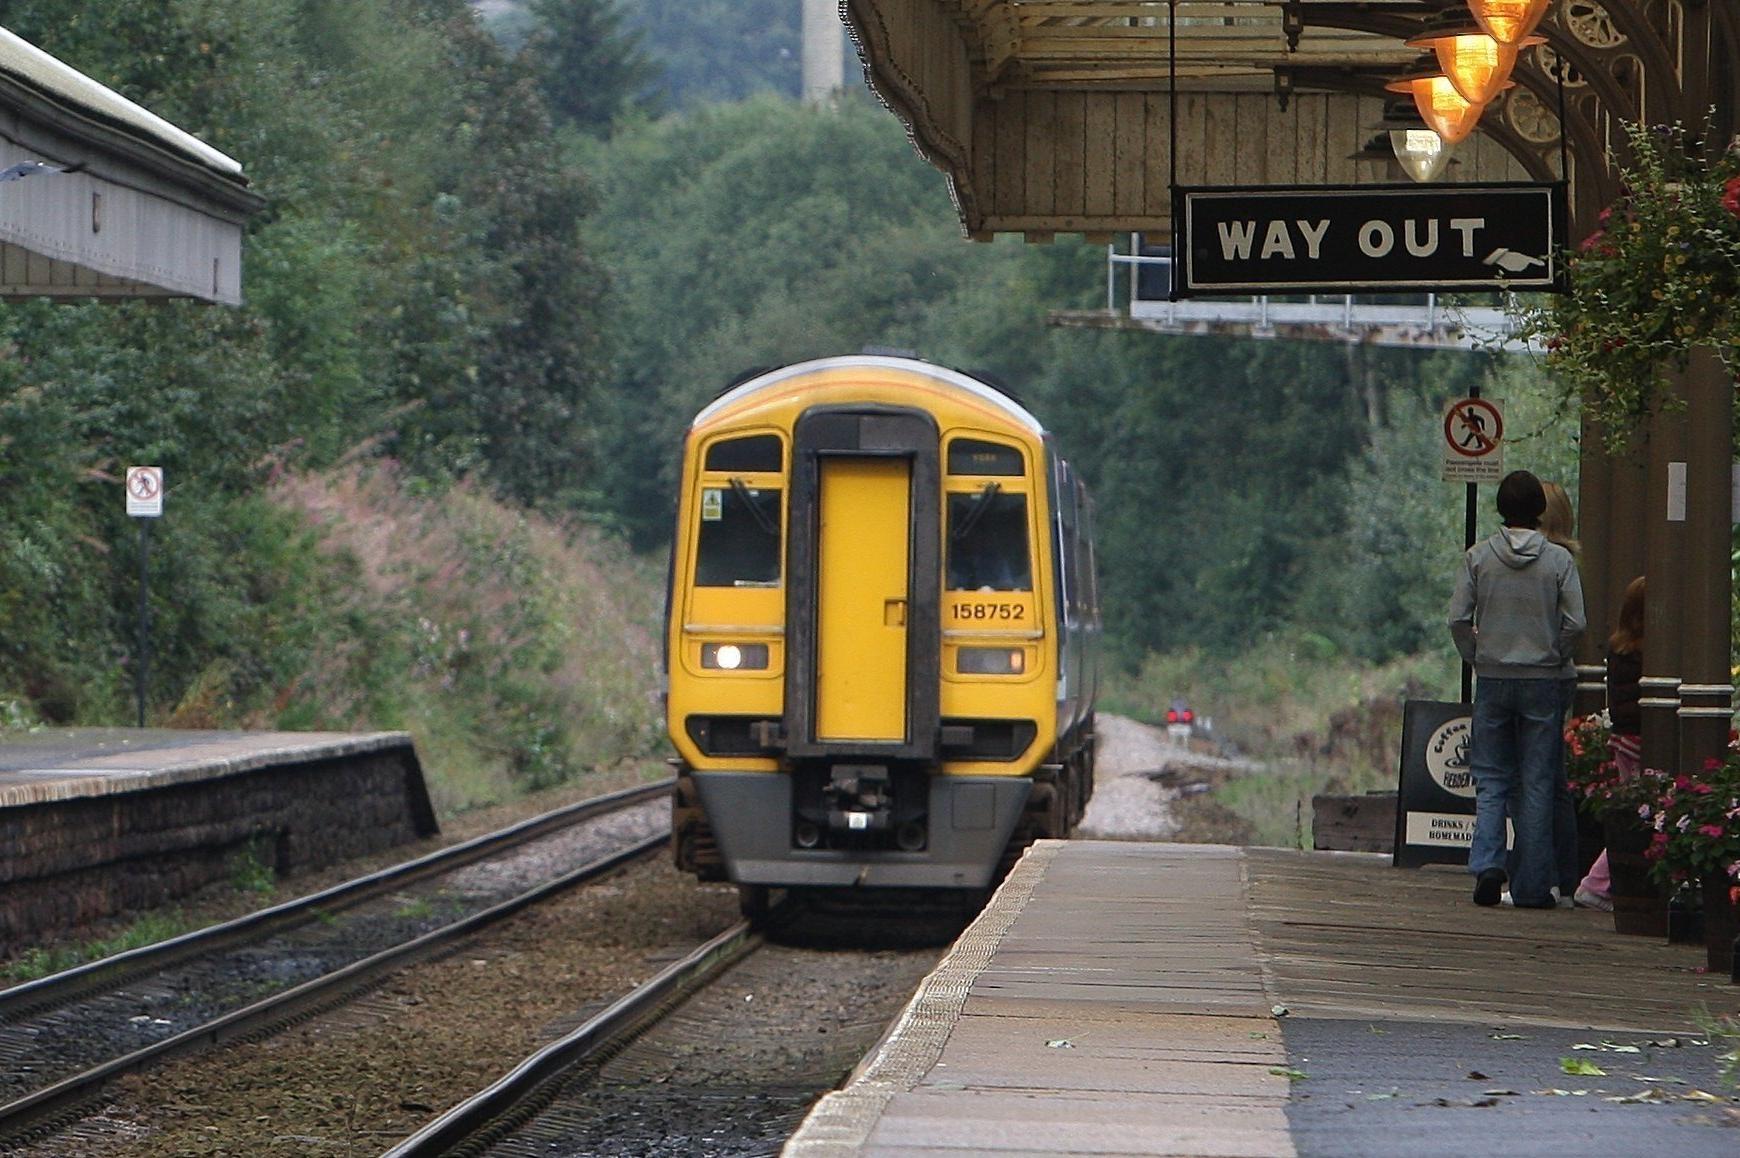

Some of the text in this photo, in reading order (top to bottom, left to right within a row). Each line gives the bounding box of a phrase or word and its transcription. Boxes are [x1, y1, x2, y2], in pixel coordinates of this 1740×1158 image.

[1217, 217, 1485, 261] WAY OUT
[952, 603, 1025, 619] 158752
[1434, 724, 1467, 754] Coffee
[1431, 818, 1463, 829] DRINKS
[1428, 831, 1473, 841] HOMEMAD
